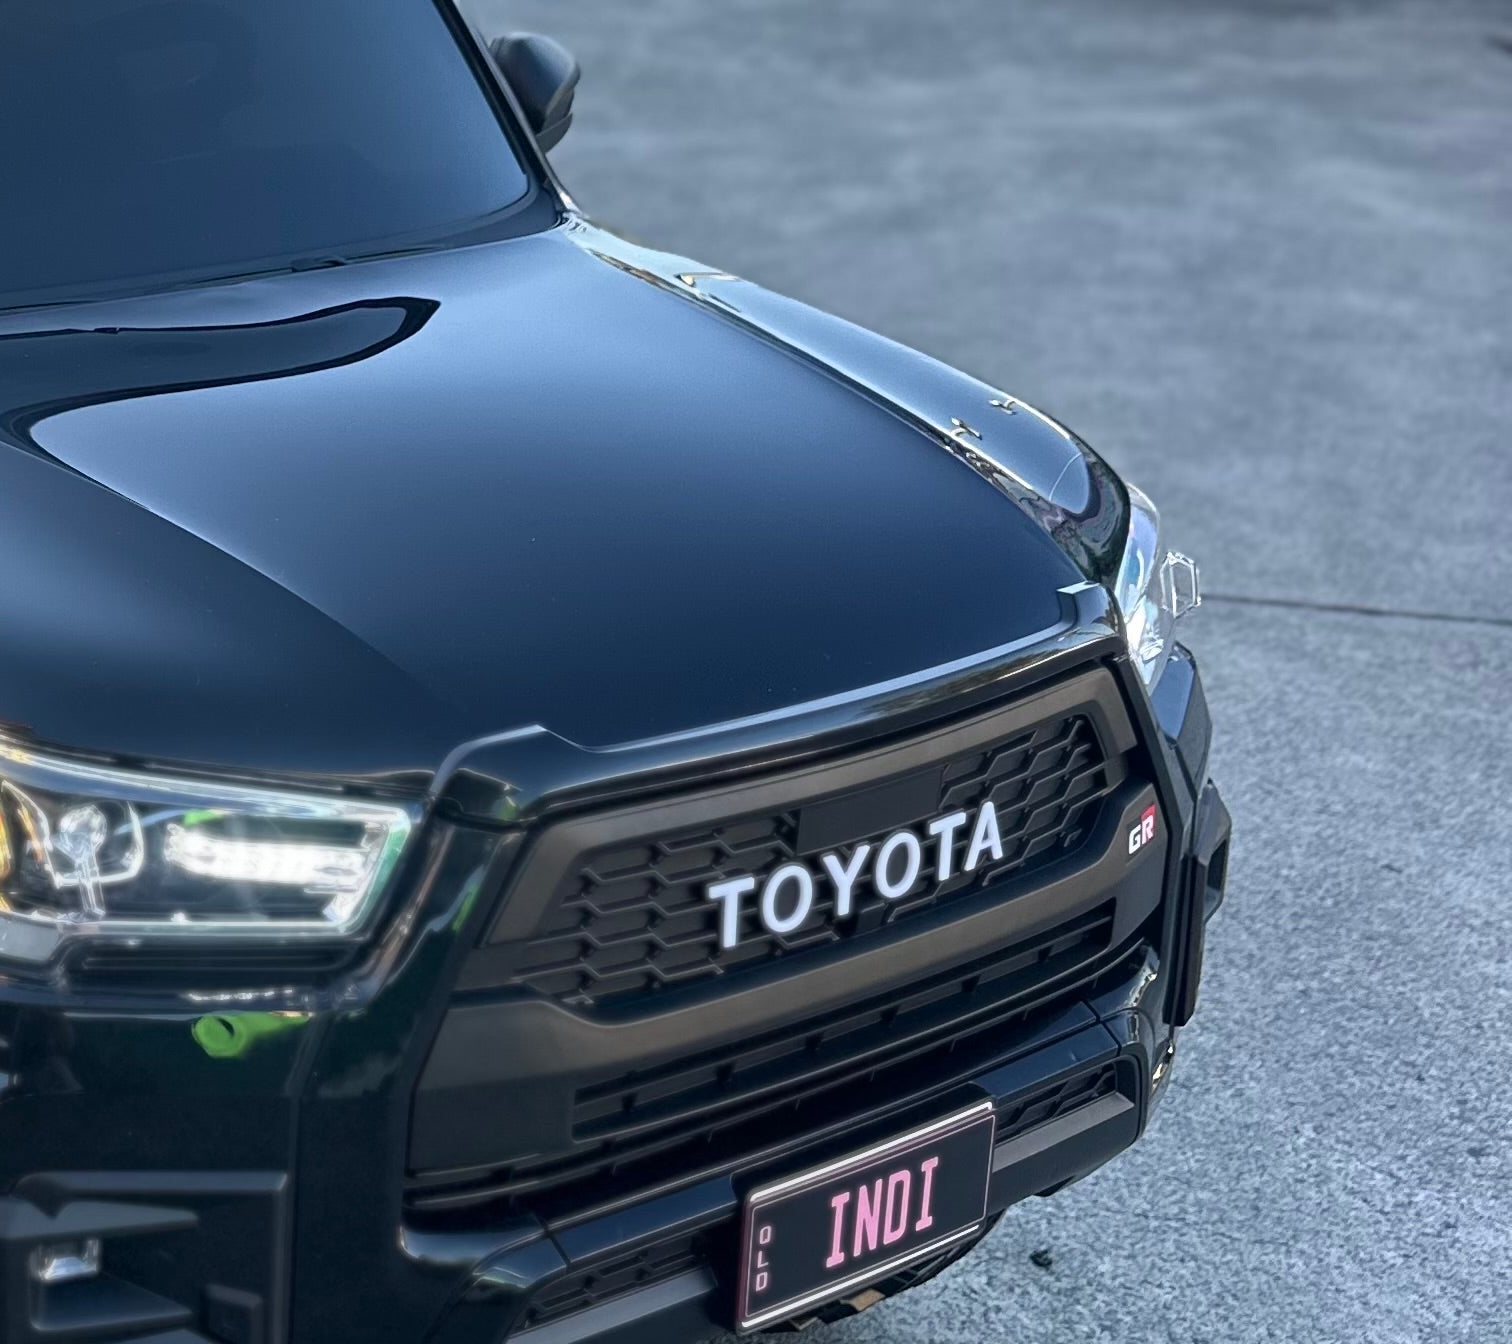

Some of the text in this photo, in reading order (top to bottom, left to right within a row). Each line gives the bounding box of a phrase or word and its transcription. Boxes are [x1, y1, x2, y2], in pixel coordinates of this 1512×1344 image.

[708, 801, 1003, 948] TOYOTA
[1128, 814, 1155, 855] GR
[825, 1156, 938, 1268] INDI
[755, 1225, 772, 1292] QLD
